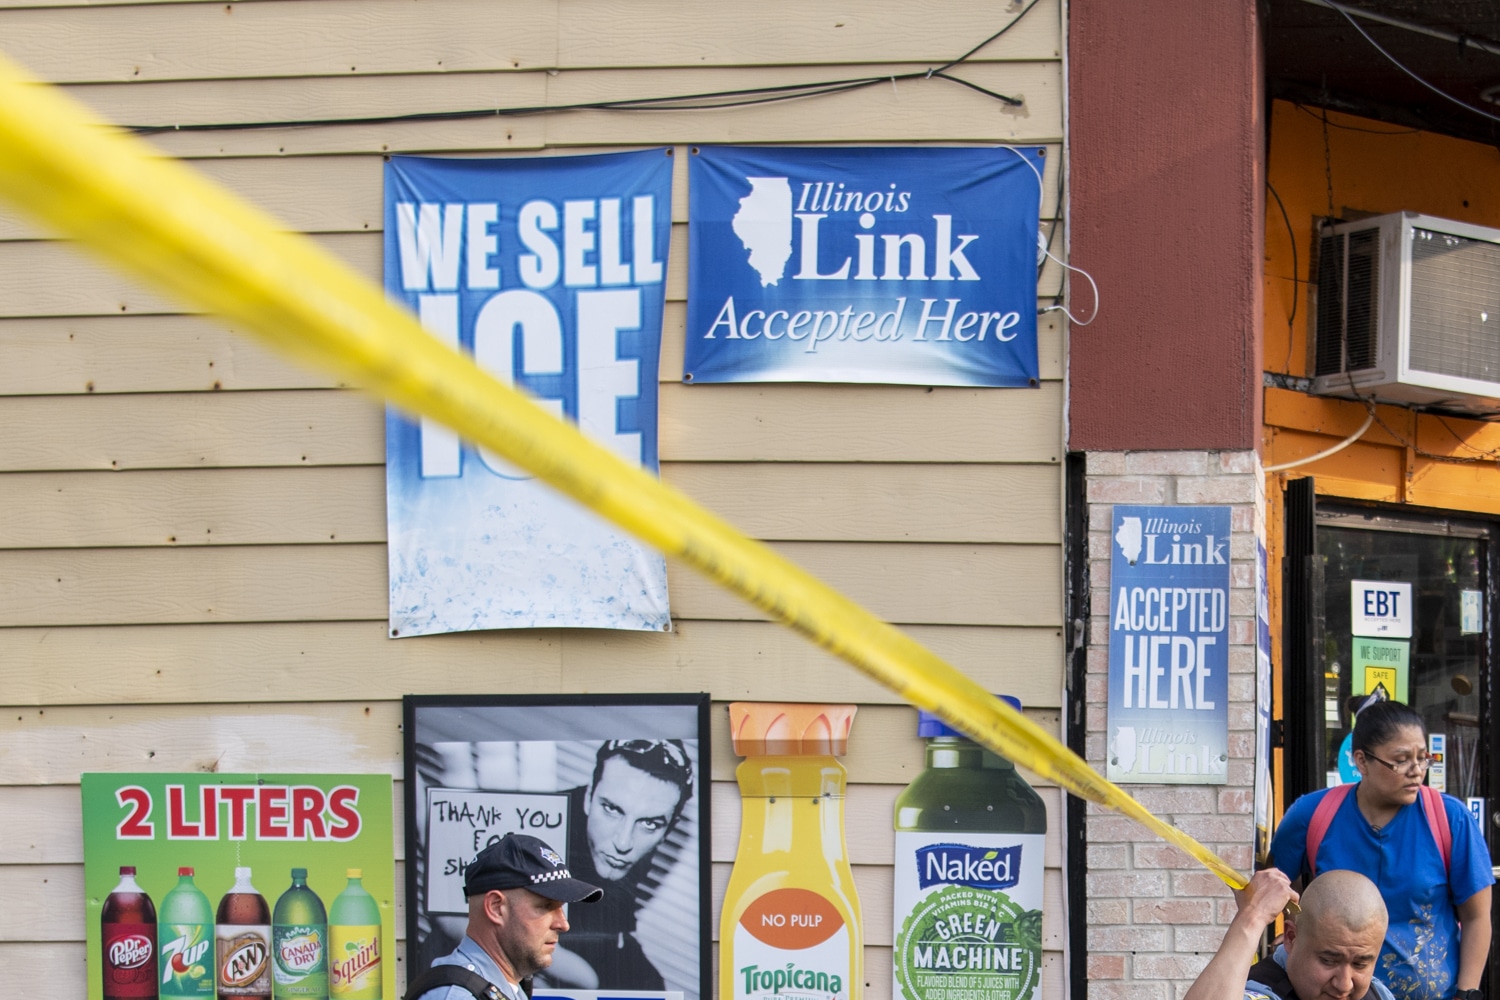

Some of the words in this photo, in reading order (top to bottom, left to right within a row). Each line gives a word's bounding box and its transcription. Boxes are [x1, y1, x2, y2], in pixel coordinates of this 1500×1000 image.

[796, 182, 911, 213] Illinois
[396, 202, 500, 290] WE
[518, 195, 663, 290] SELL
[792, 212, 981, 281] Link
[703, 296, 907, 354] Accepted
[911, 298, 1021, 343] Here
[419, 288, 643, 479] ICE
[1143, 517, 1203, 535] Illinois
[1142, 533, 1227, 565] Link
[1113, 586, 1226, 633] ACCEPTED
[1363, 589, 1401, 618] EBT
[1360, 645, 1371, 660] WE
[1372, 646, 1402, 663] SUPPORT
[1123, 634, 1217, 711] HERE
[1372, 671, 1389, 680] SAFE
[1138, 727, 1198, 745] Illinois
[1137, 744, 1224, 776] Link
[116, 785, 154, 840] 2
[167, 785, 361, 841] LITERS
[433, 800, 502, 828] THANK
[516, 808, 563, 830] YOU
[926, 851, 1011, 882] Naked
[932, 900, 972, 917] VITAMINS
[973, 901, 989, 909] B12
[940, 892, 973, 903] PACKED
[976, 892, 998, 904] WITH
[762, 914, 786, 927] NO
[791, 914, 823, 928] PULP
[935, 912, 1001, 941] GREEN
[114, 942, 151, 966] Pepper
[123, 938, 141, 951] Dr
[281, 940, 323, 961] CANADA
[293, 952, 316, 966] DRY
[913, 945, 1023, 970] MACHINE
[230, 943, 258, 982] A&W
[331, 937, 379, 985] Squirt
[740, 963, 842, 995] Tropicana
[917, 975, 948, 988] FLAVORED
[948, 976, 968, 988] BLEND
[968, 977, 977, 988] OF
[983, 977, 1003, 989] JUICES
[1004, 978, 1020, 990] WITH
[925, 988, 946, 1000] ADDED
[946, 989, 985, 1000] INGREDIENTS
